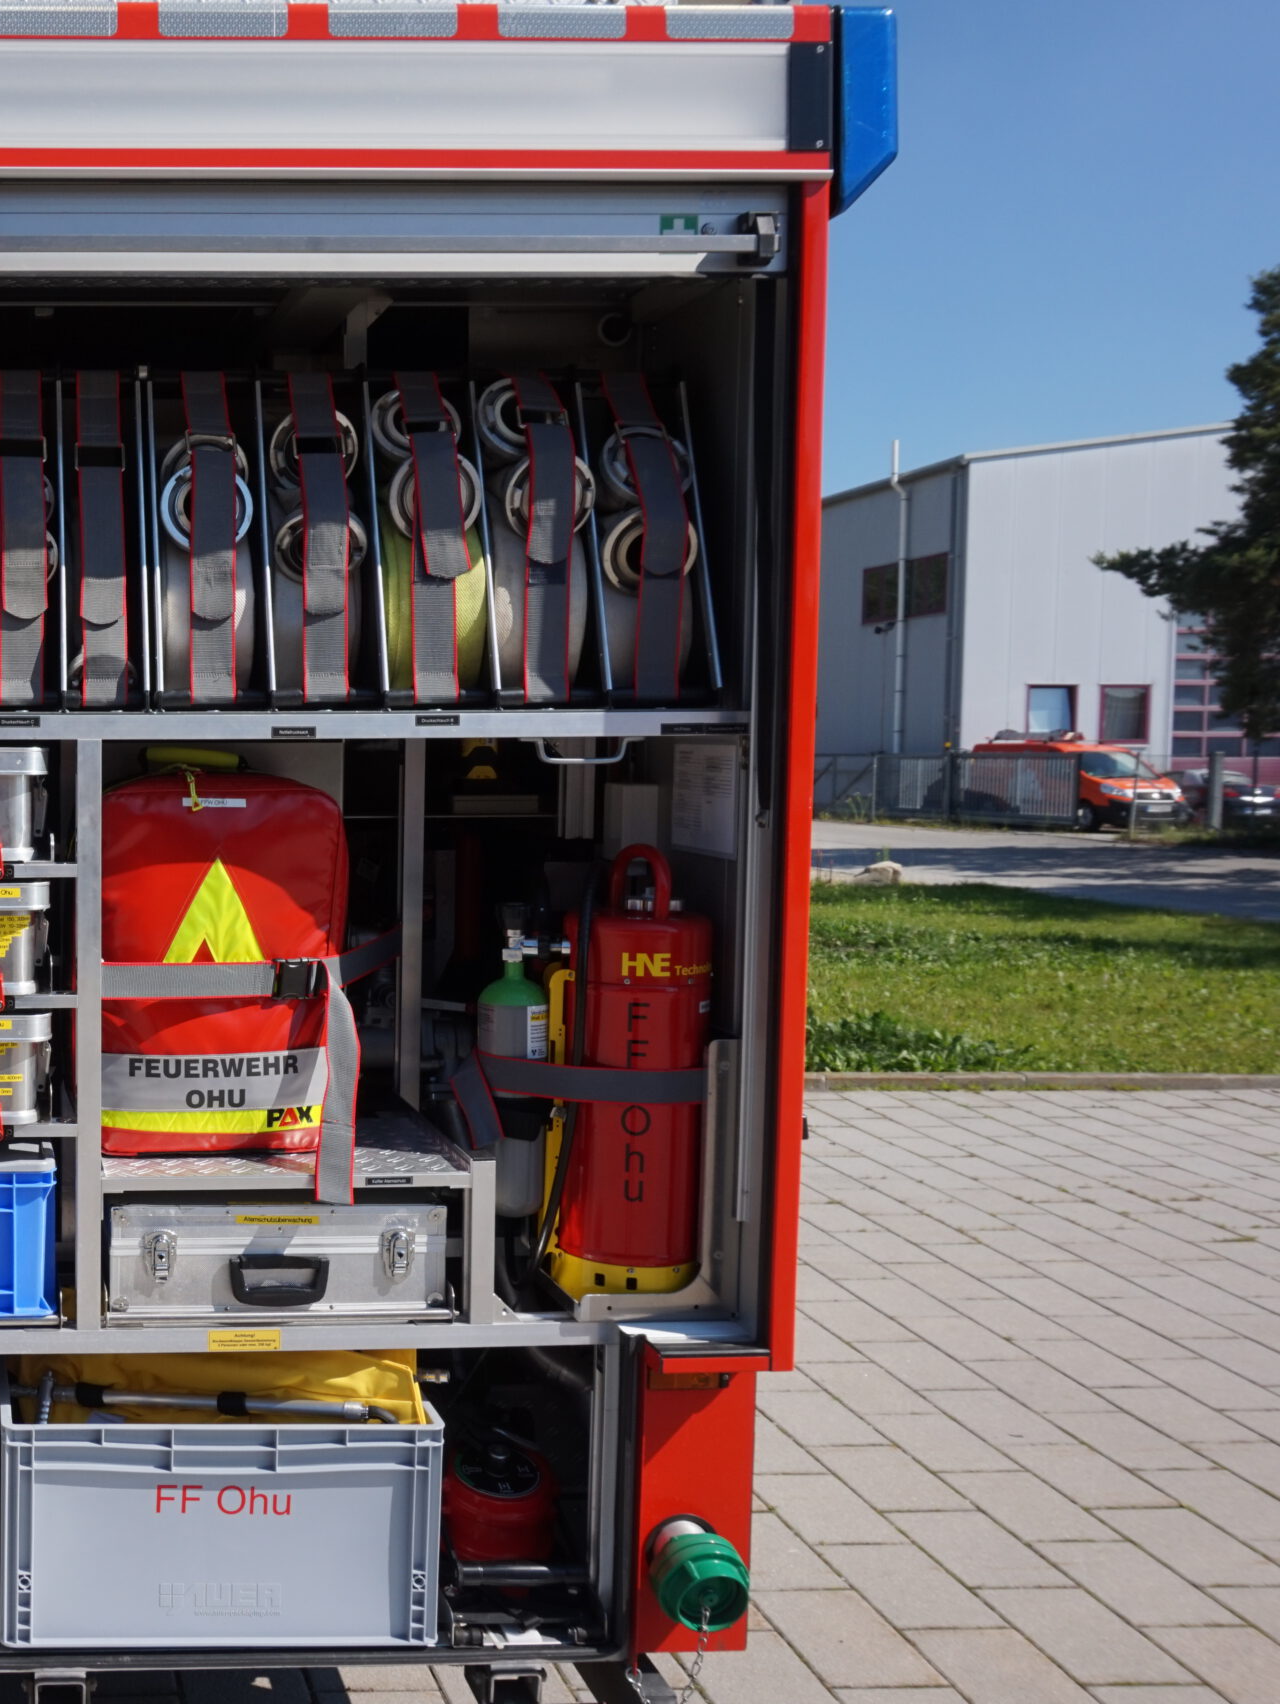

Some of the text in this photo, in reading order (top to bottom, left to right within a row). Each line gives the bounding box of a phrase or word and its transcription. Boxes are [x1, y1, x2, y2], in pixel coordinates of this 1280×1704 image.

[622, 952, 671, 977] HNE
[128, 1055, 299, 1079] FEUERWEHR
[185, 1088, 246, 1109] OHU
[266, 1105, 314, 1128] PAX
[620, 1105, 652, 1203] Ohu
[243, 1215, 313, 1224] Atemschutzüberwachung
[155, 1486, 293, 1516] FF Ohu
